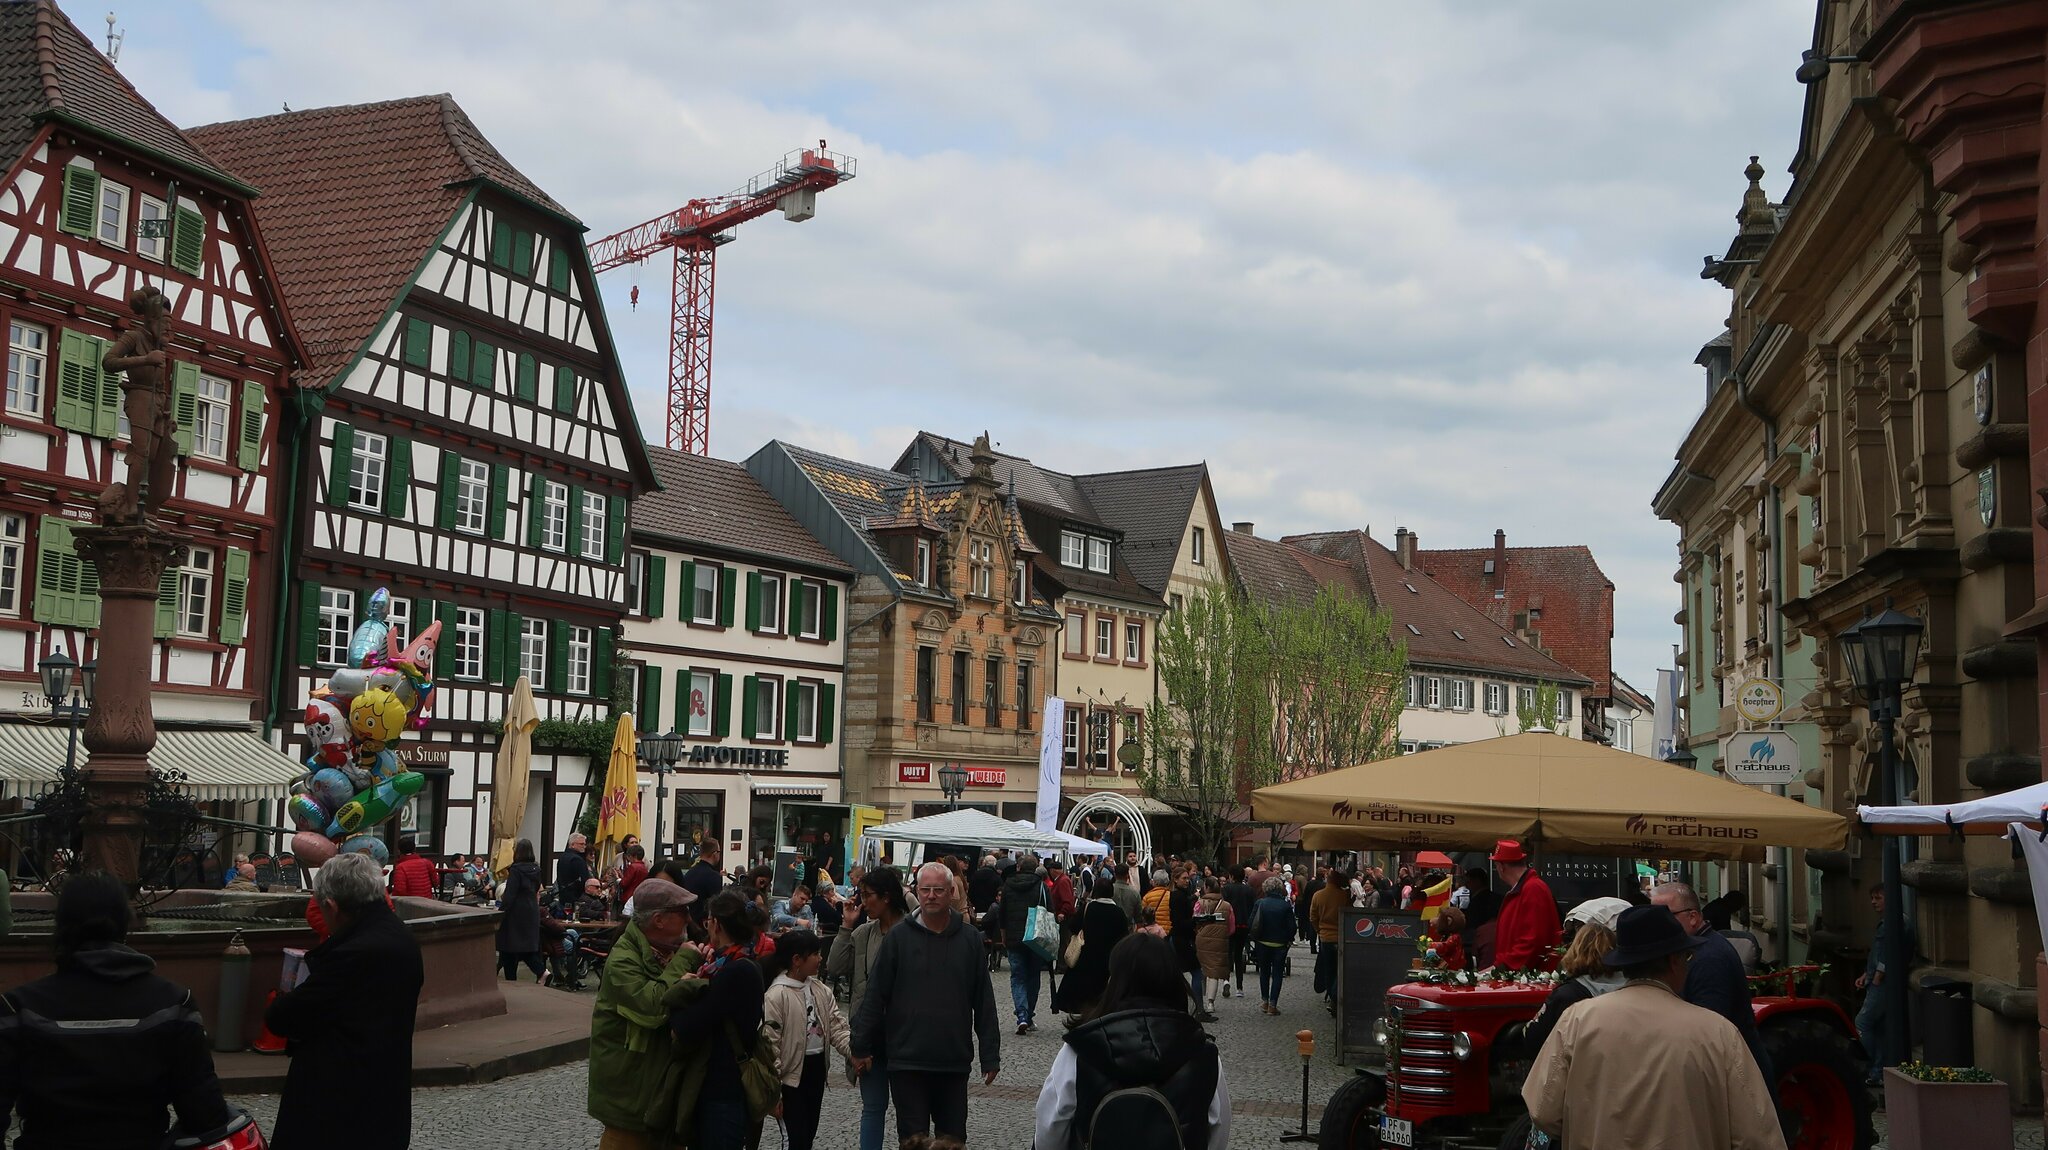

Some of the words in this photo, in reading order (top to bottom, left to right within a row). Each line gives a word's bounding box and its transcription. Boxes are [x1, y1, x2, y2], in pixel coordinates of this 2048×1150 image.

[903, 766, 926, 776] WITT
[1735, 763, 1791, 771] rathaus
[1356, 809, 1455, 825] rathaus
[1664, 815, 1697, 823] altes
[1652, 823, 1759, 840] rathaus
[1375, 923, 1411, 938] MAX
[1388, 1118, 1398, 1130] PF
